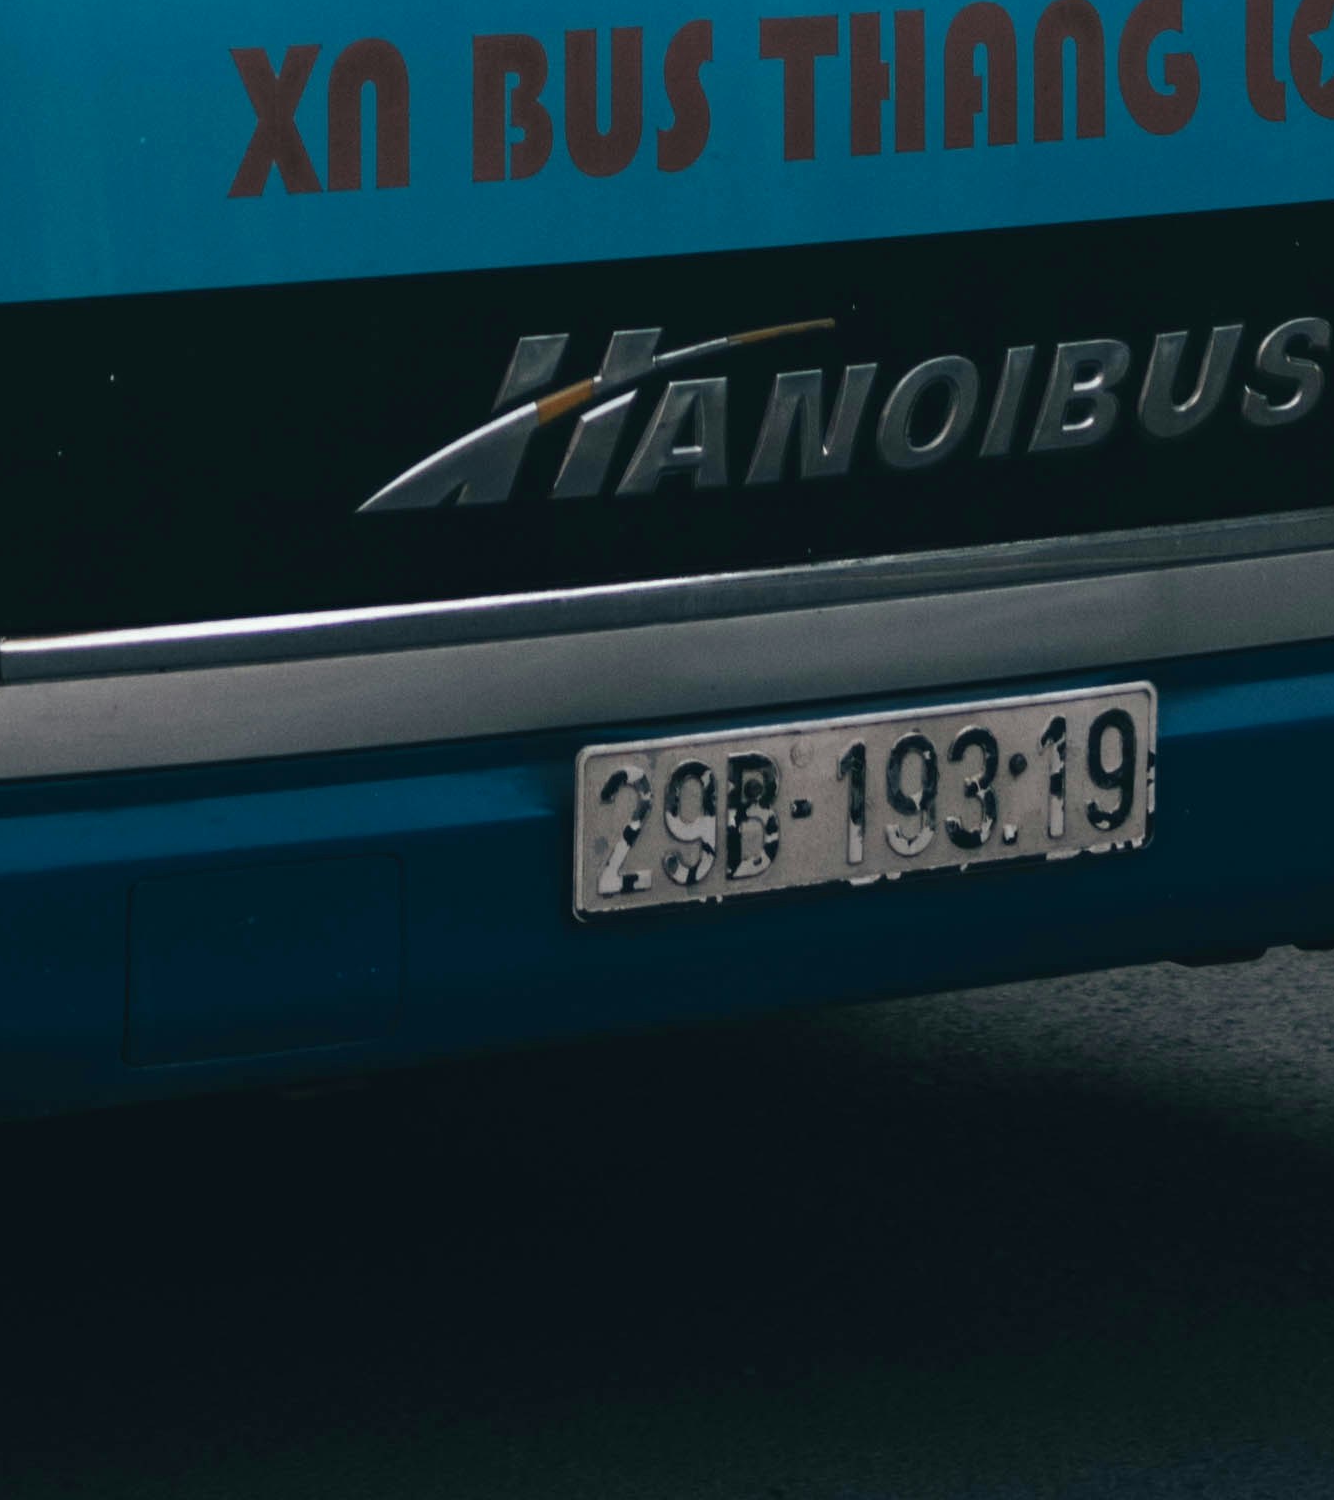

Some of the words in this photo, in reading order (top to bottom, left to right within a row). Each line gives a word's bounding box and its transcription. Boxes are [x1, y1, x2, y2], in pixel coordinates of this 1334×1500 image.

[227, 43, 410, 198] XN
[471, 19, 713, 183] BUS
[357, 316, 1331, 513] HANOIBUS
